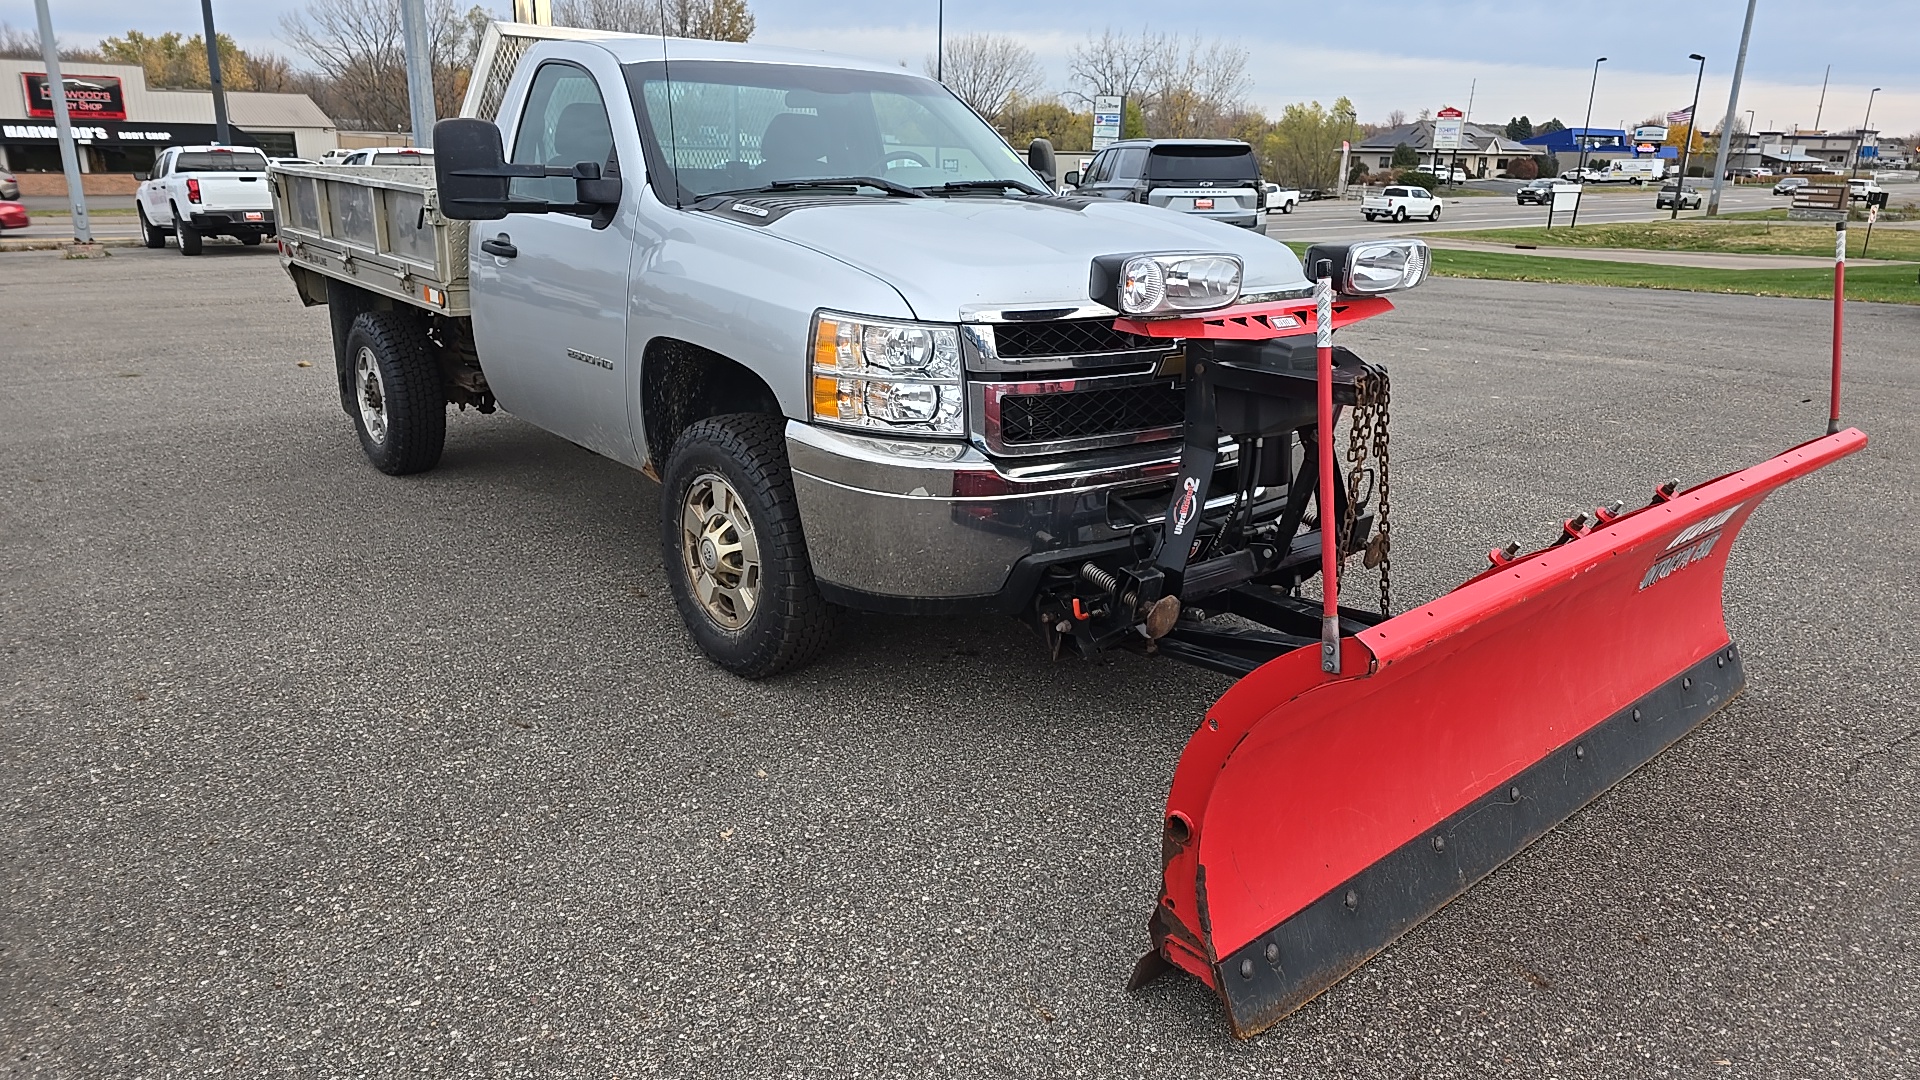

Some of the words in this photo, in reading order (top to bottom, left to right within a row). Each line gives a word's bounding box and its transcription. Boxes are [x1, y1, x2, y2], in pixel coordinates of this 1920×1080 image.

[40, 87, 110, 100] HWOOD'S
[3, 125, 108, 139] HARWOD'S
[118, 131, 145, 140] BODY
[145, 132, 171, 140] SHOP
